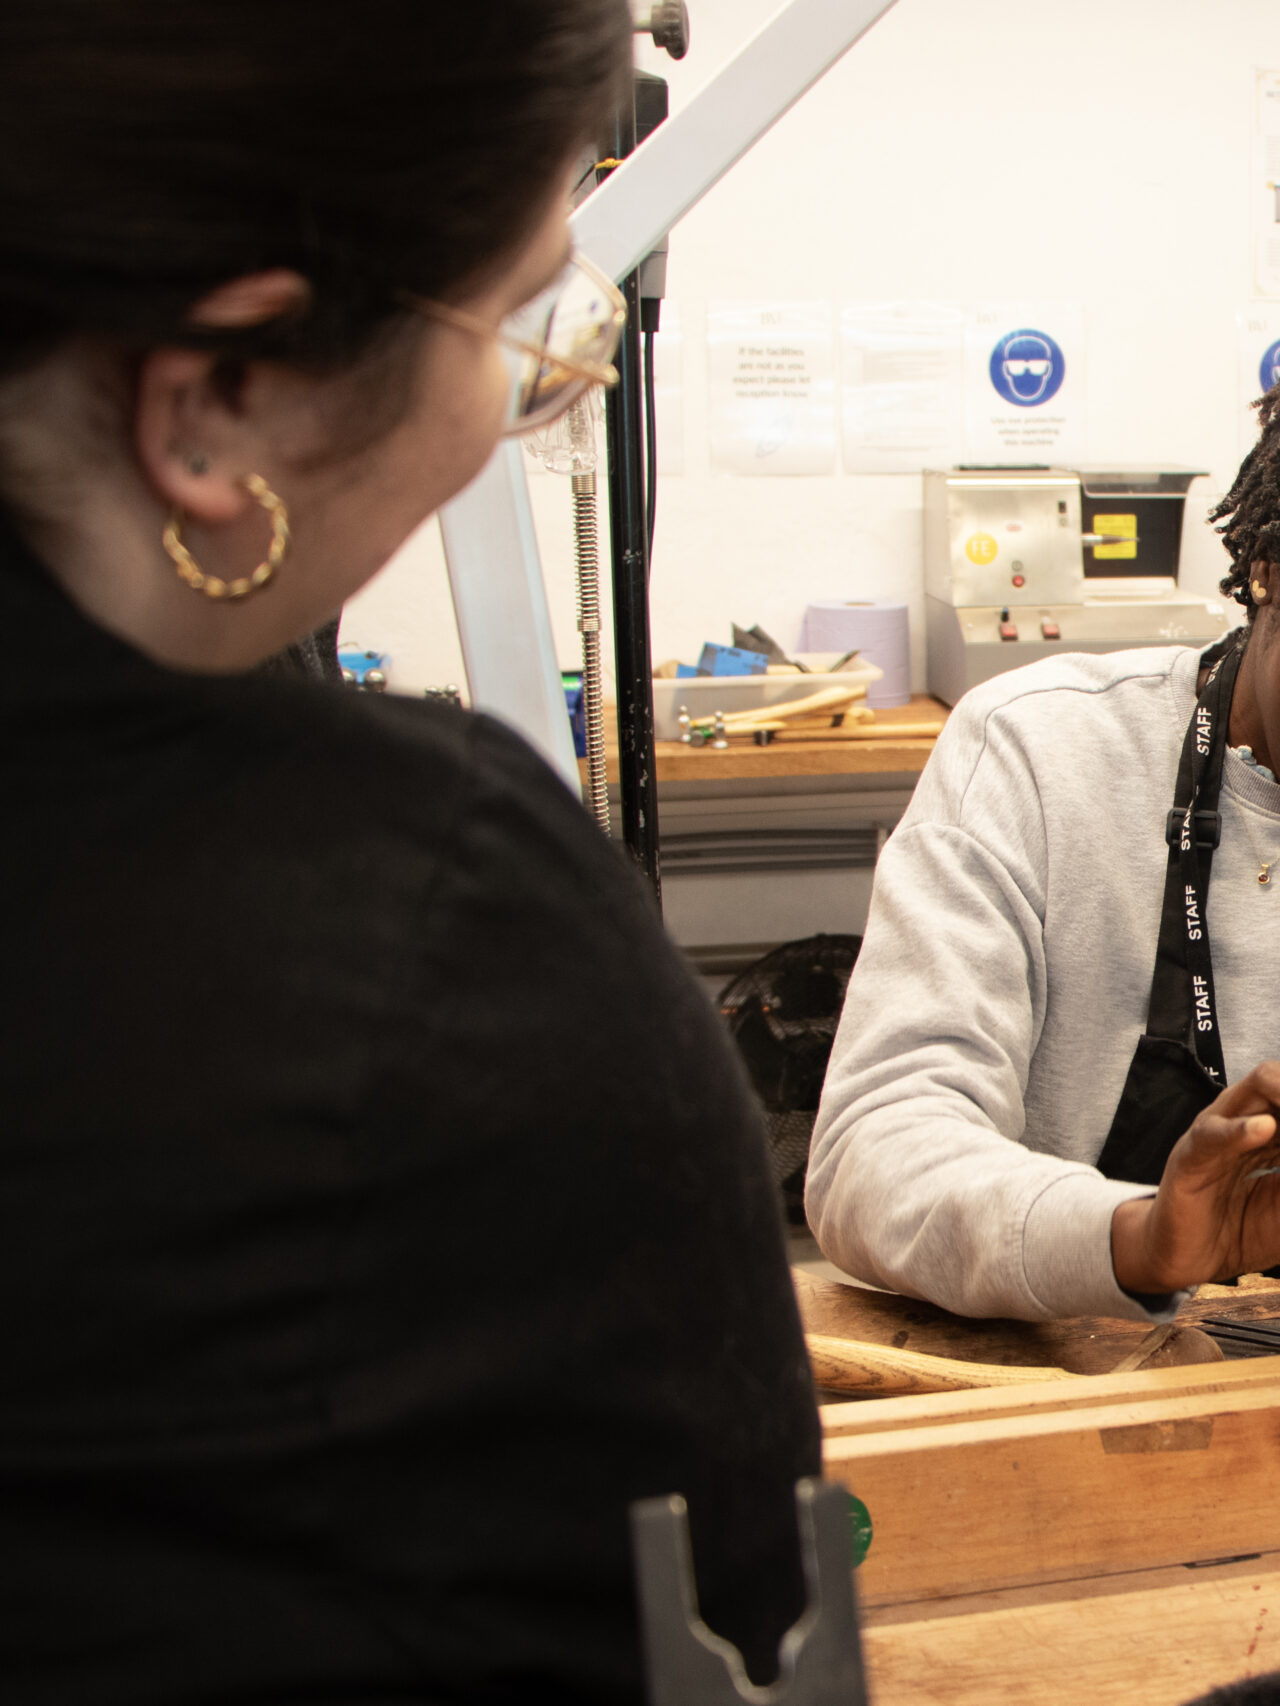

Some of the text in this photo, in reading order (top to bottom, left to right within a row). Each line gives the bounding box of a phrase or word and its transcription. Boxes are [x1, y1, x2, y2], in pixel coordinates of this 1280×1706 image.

[748, 347, 763, 356] the
[766, 347, 804, 356] facilities
[732, 375, 810, 384] expect please let
[739, 362, 753, 370] are
[756, 362, 771, 370] not
[787, 363, 805, 371] you
[1196, 706, 1212, 756] STAFF
[1185, 884, 1202, 941] STAFF
[1193, 975, 1212, 1031] STAFF
